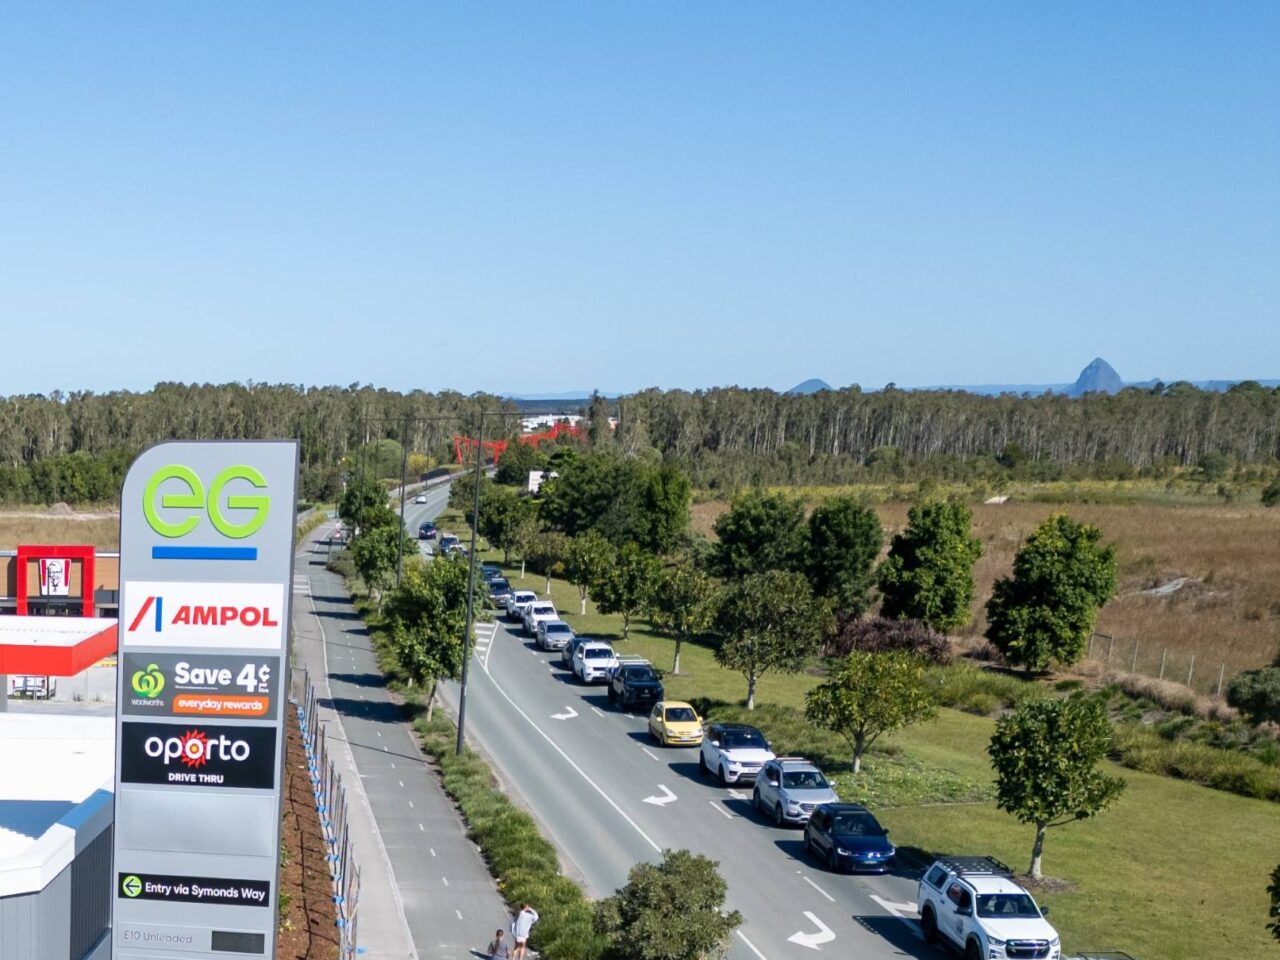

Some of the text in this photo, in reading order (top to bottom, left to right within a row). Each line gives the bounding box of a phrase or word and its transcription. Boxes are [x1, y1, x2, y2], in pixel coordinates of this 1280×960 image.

[172, 605, 278, 627] AMPOL
[175, 662, 232, 685] Save
[178, 699, 263, 710] everyday rewards
[145, 734, 250, 765] oporto
[168, 772, 224, 783] DRIVE THRU
[145, 882, 266, 902] Entry via Symonds Way
[124, 930, 193, 944] E10 Unleaded
